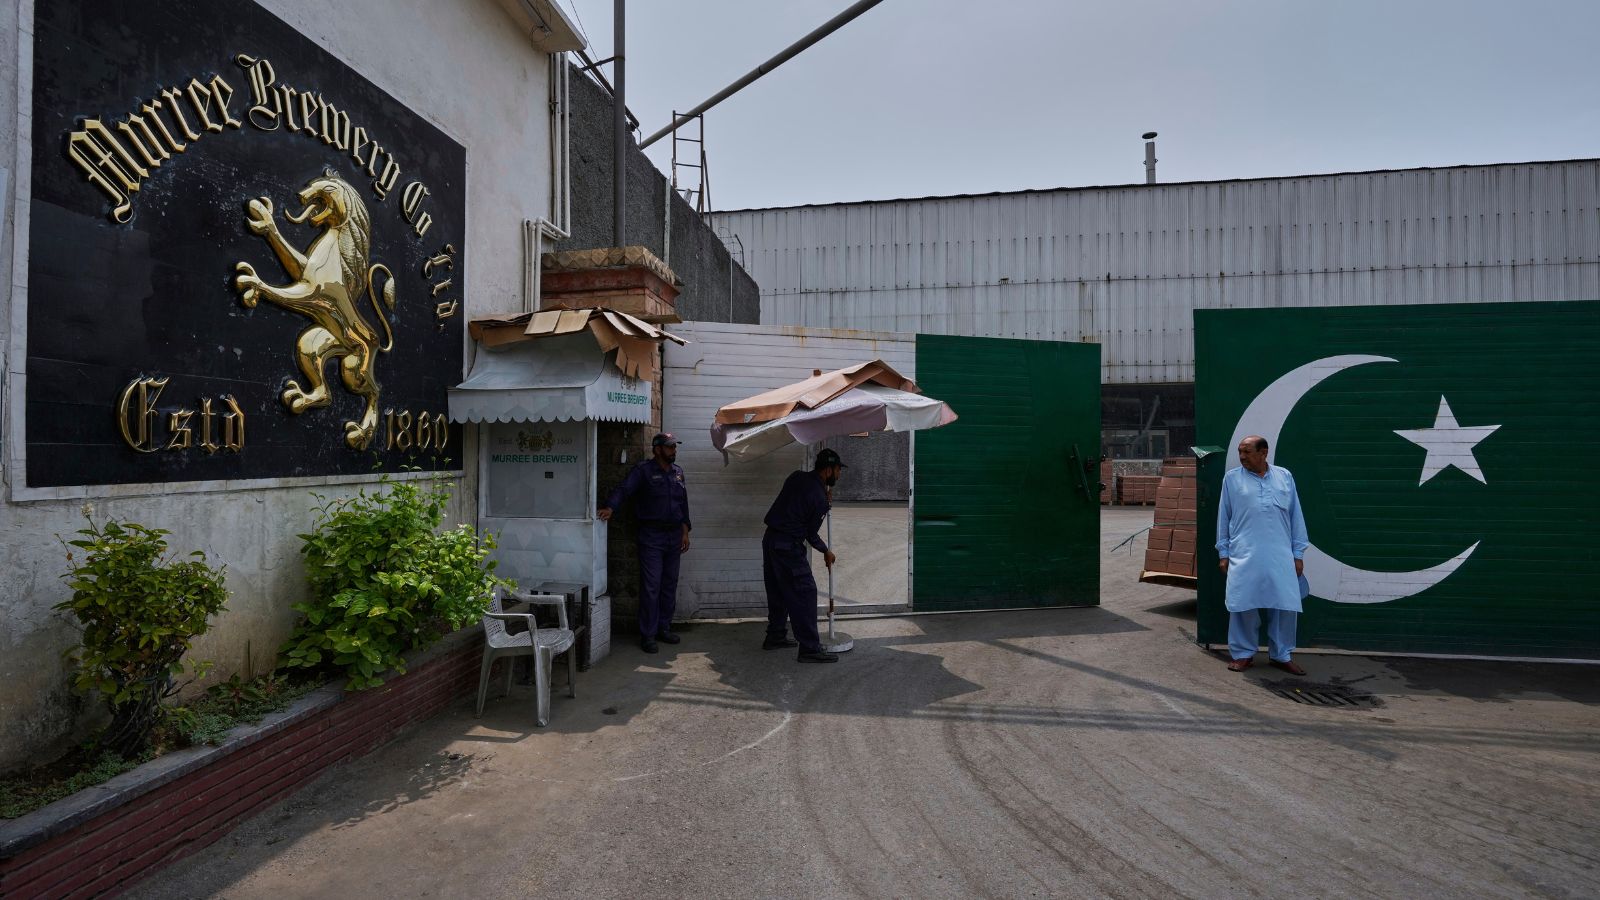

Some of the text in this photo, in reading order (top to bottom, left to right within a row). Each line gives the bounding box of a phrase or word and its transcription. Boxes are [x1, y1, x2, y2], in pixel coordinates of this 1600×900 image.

[69, 75, 242, 223] Murree
[236, 53, 401, 201] Brewery
[403, 181, 433, 238] Co
[118, 376, 449, 454] Estd 1860
[607, 391, 647, 405] MURREE BREWERY
[492, 454, 578, 463] MURREE BREWERY
